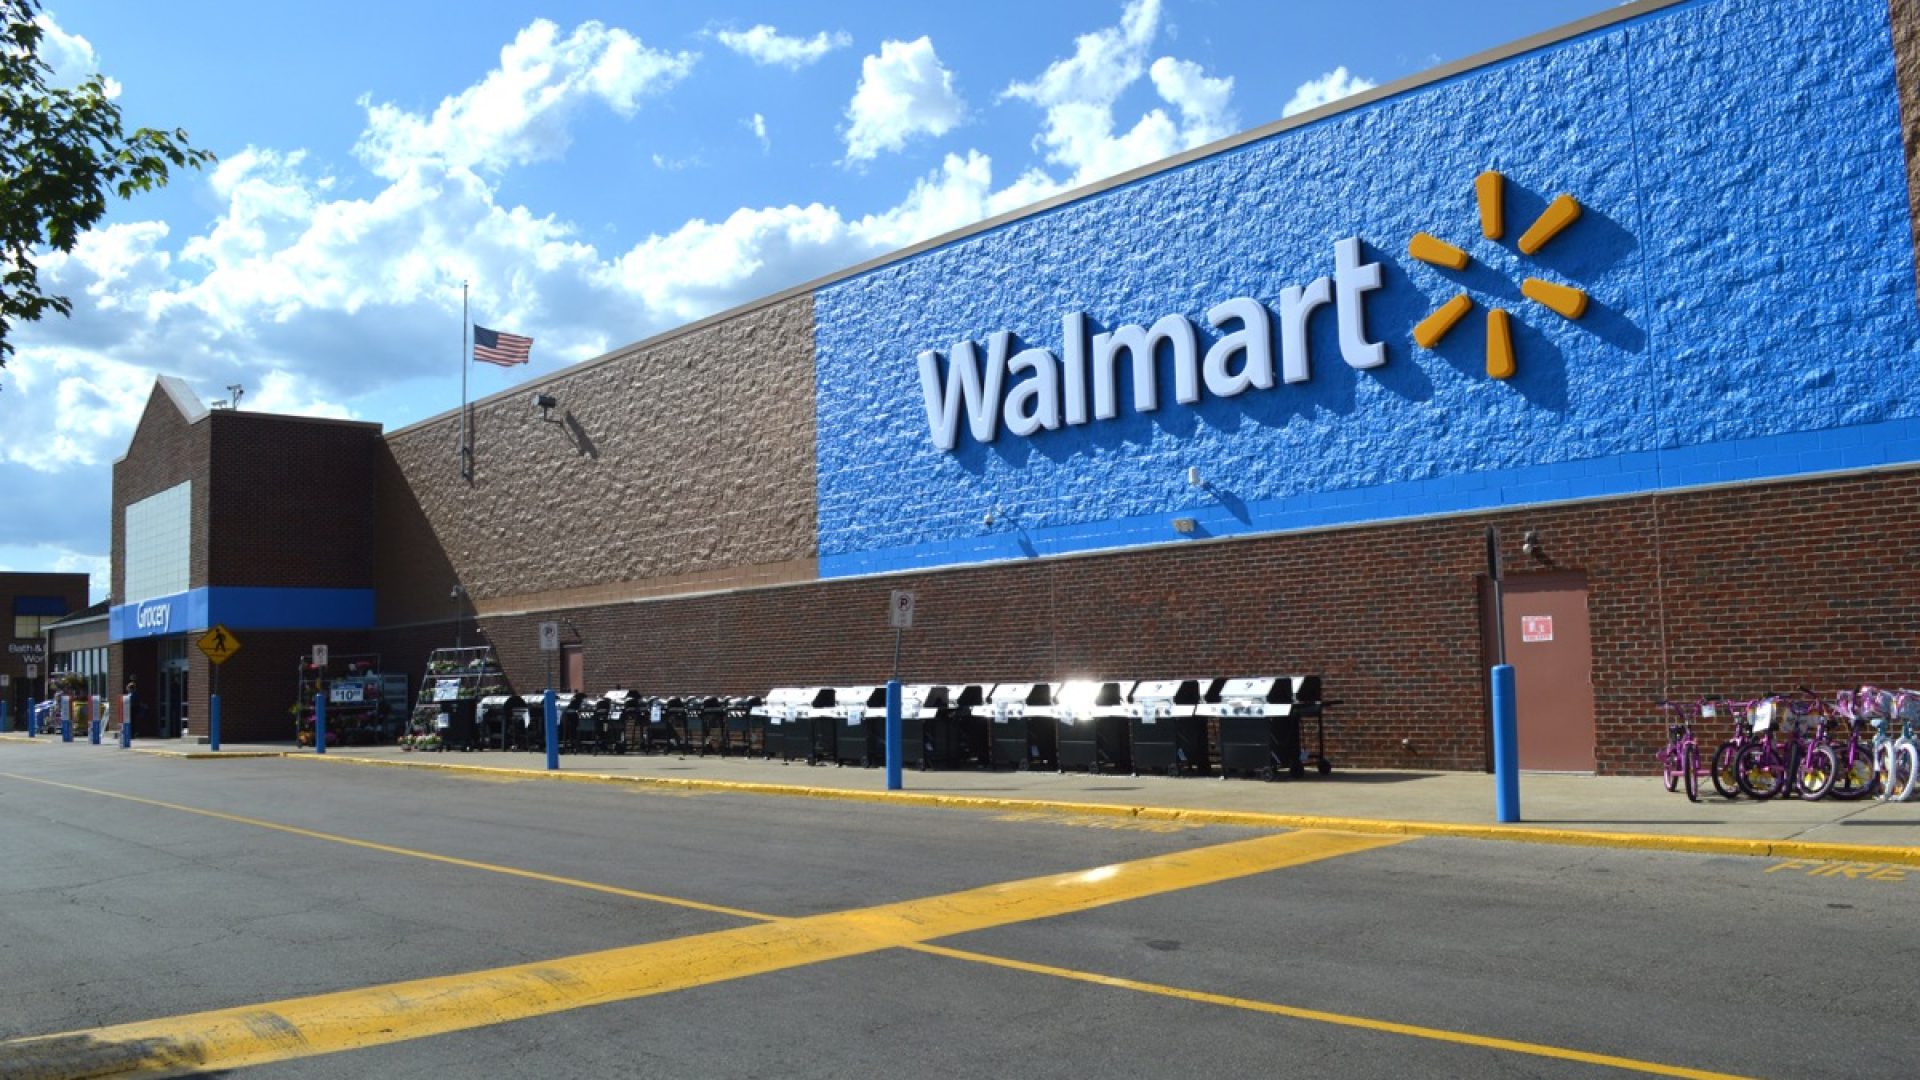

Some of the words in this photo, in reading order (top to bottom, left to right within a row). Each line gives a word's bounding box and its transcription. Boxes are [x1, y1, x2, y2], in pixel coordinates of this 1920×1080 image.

[917, 237, 1386, 451] Walmart
[137, 602, 171, 632] Grocery
[8, 643, 33, 653] Bath
[23, 655, 44, 663] Wor
[1764, 859, 1907, 881] FIRE
